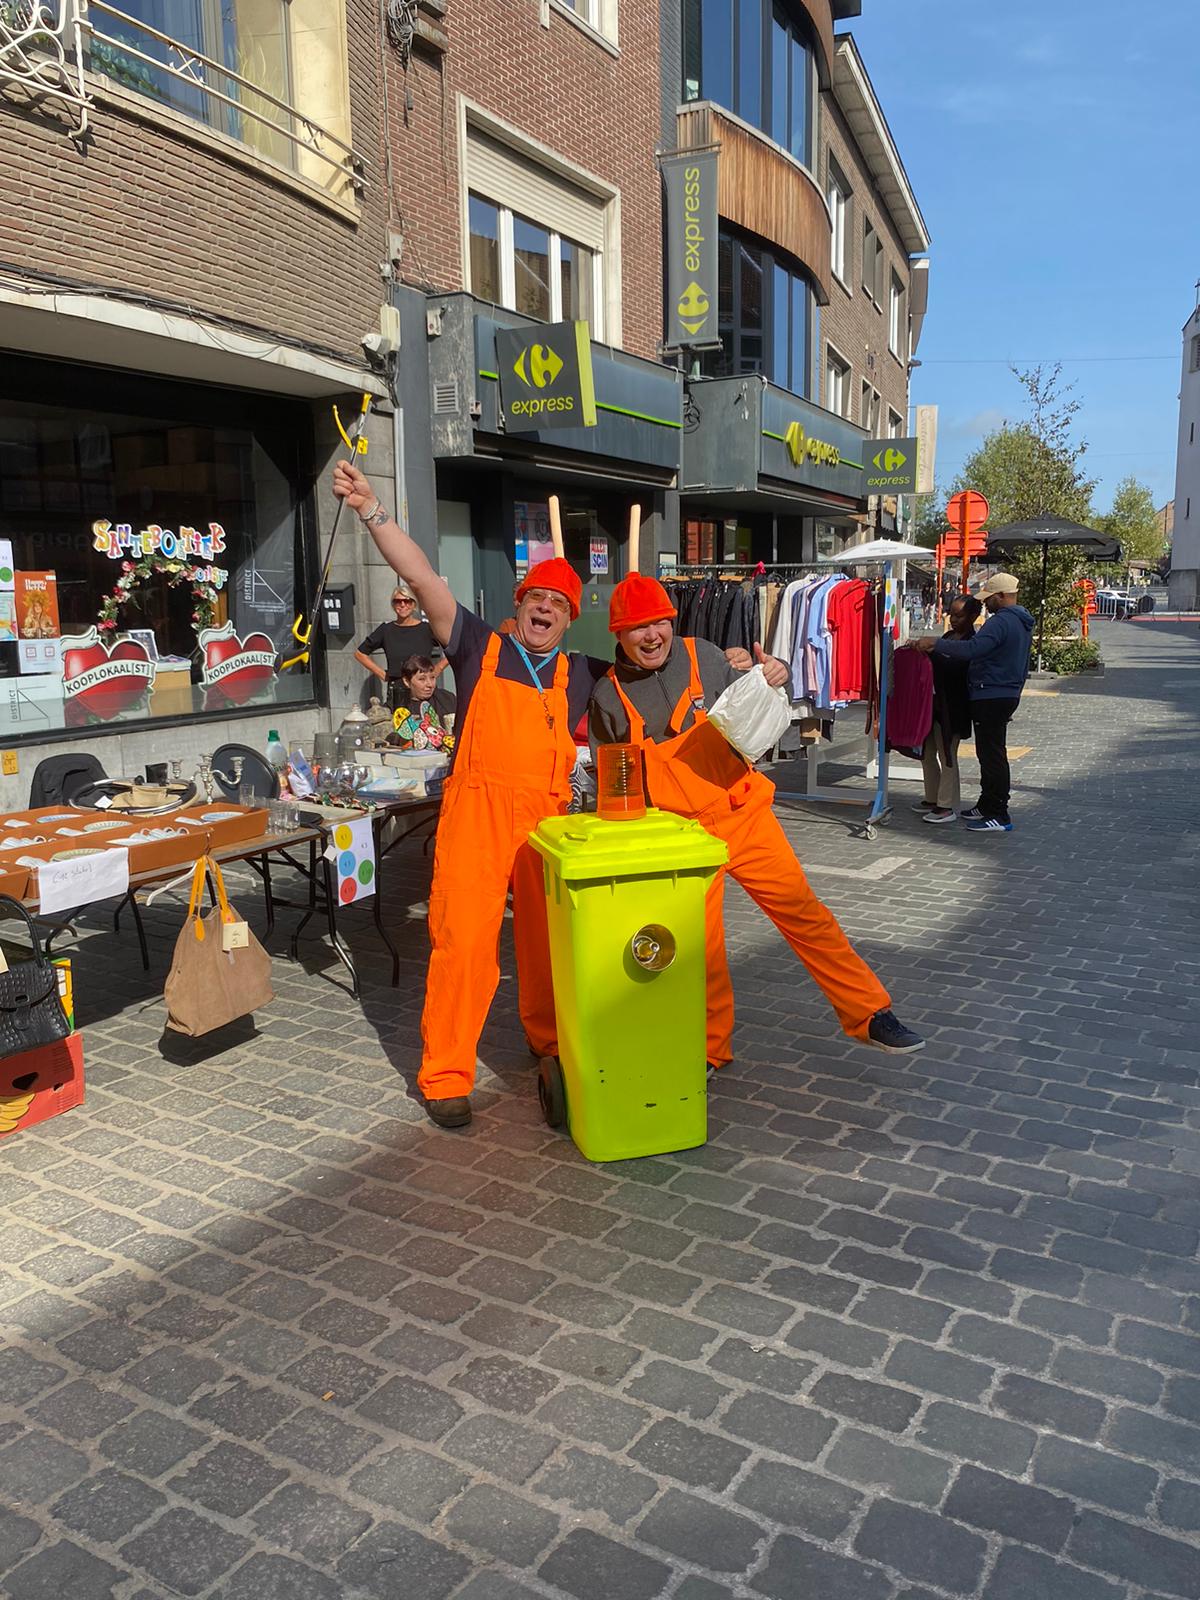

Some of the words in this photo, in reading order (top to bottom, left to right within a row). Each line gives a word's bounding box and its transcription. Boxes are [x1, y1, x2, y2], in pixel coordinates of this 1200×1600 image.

[684, 167, 705, 272] express
[511, 396, 575, 418] express
[866, 475, 912, 488] express
[244, 569, 252, 600] DISTRICT
[65, 662, 150, 694] KOOPLOKAAL[ST]
[9, 689, 18, 720] DISTRICT
